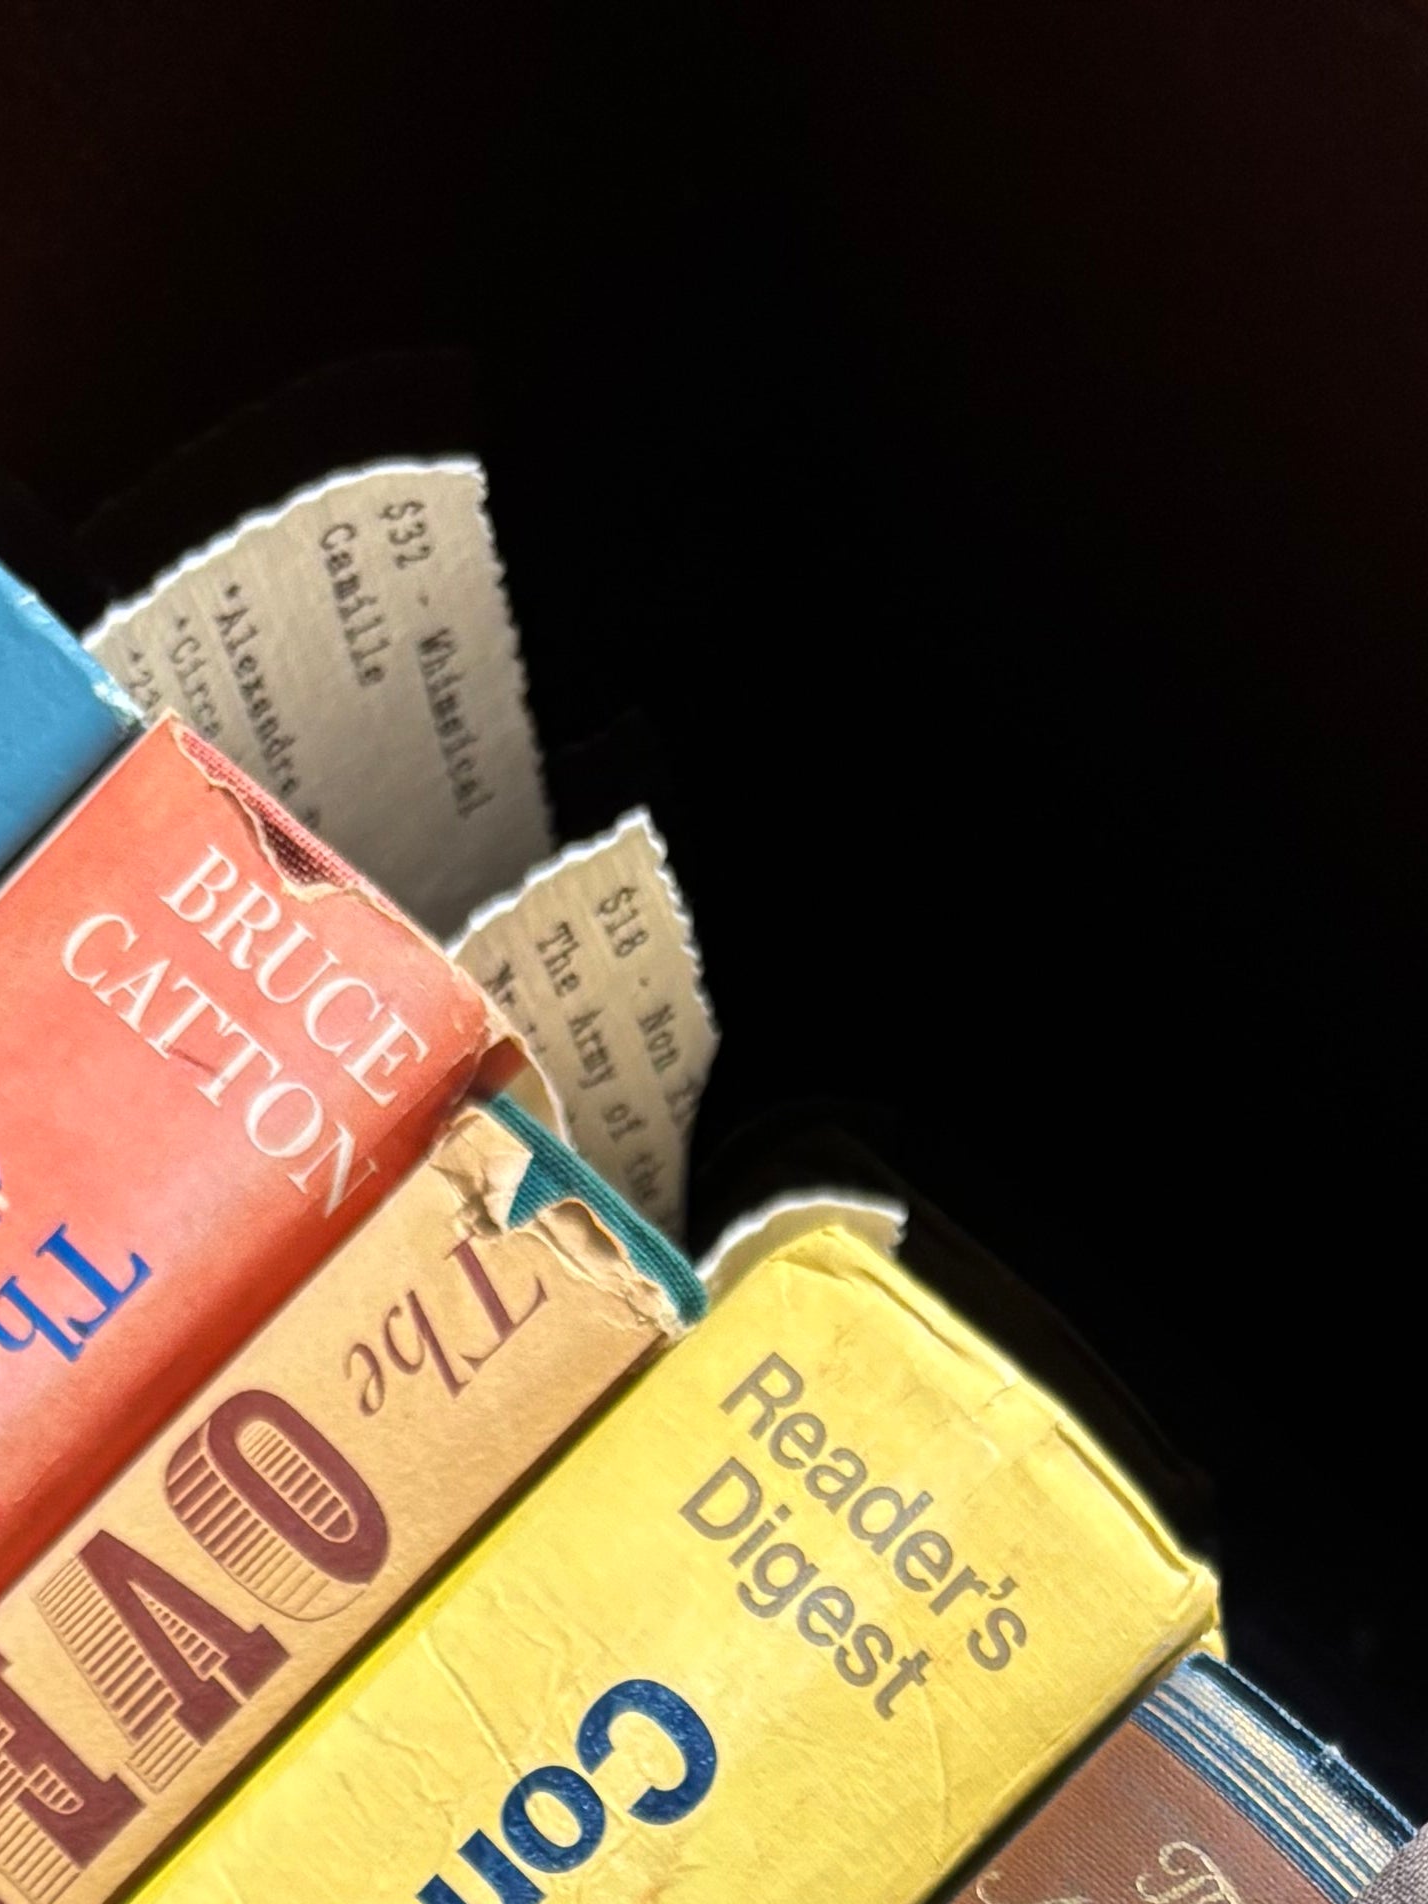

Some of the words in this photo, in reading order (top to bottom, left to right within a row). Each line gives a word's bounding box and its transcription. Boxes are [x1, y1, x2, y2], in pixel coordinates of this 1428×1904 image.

[319, 521, 394, 688] Camille
[378, 499, 432, 570] $32
[416, 627, 495, 820] Whimsical
[61, 907, 378, 1219] CATTON
[160, 843, 432, 1110] BRUCE
[535, 920, 582, 998] The
[568, 1004, 622, 1092] Army
[602, 1102, 649, 1143] of
[595, 885, 648, 958] $18
[636, 1002, 680, 1074] Non
[340, 1232, 551, 1421] The
[676, 1456, 932, 1719] Digest
[719, 1350, 1028, 1673] Reader's
